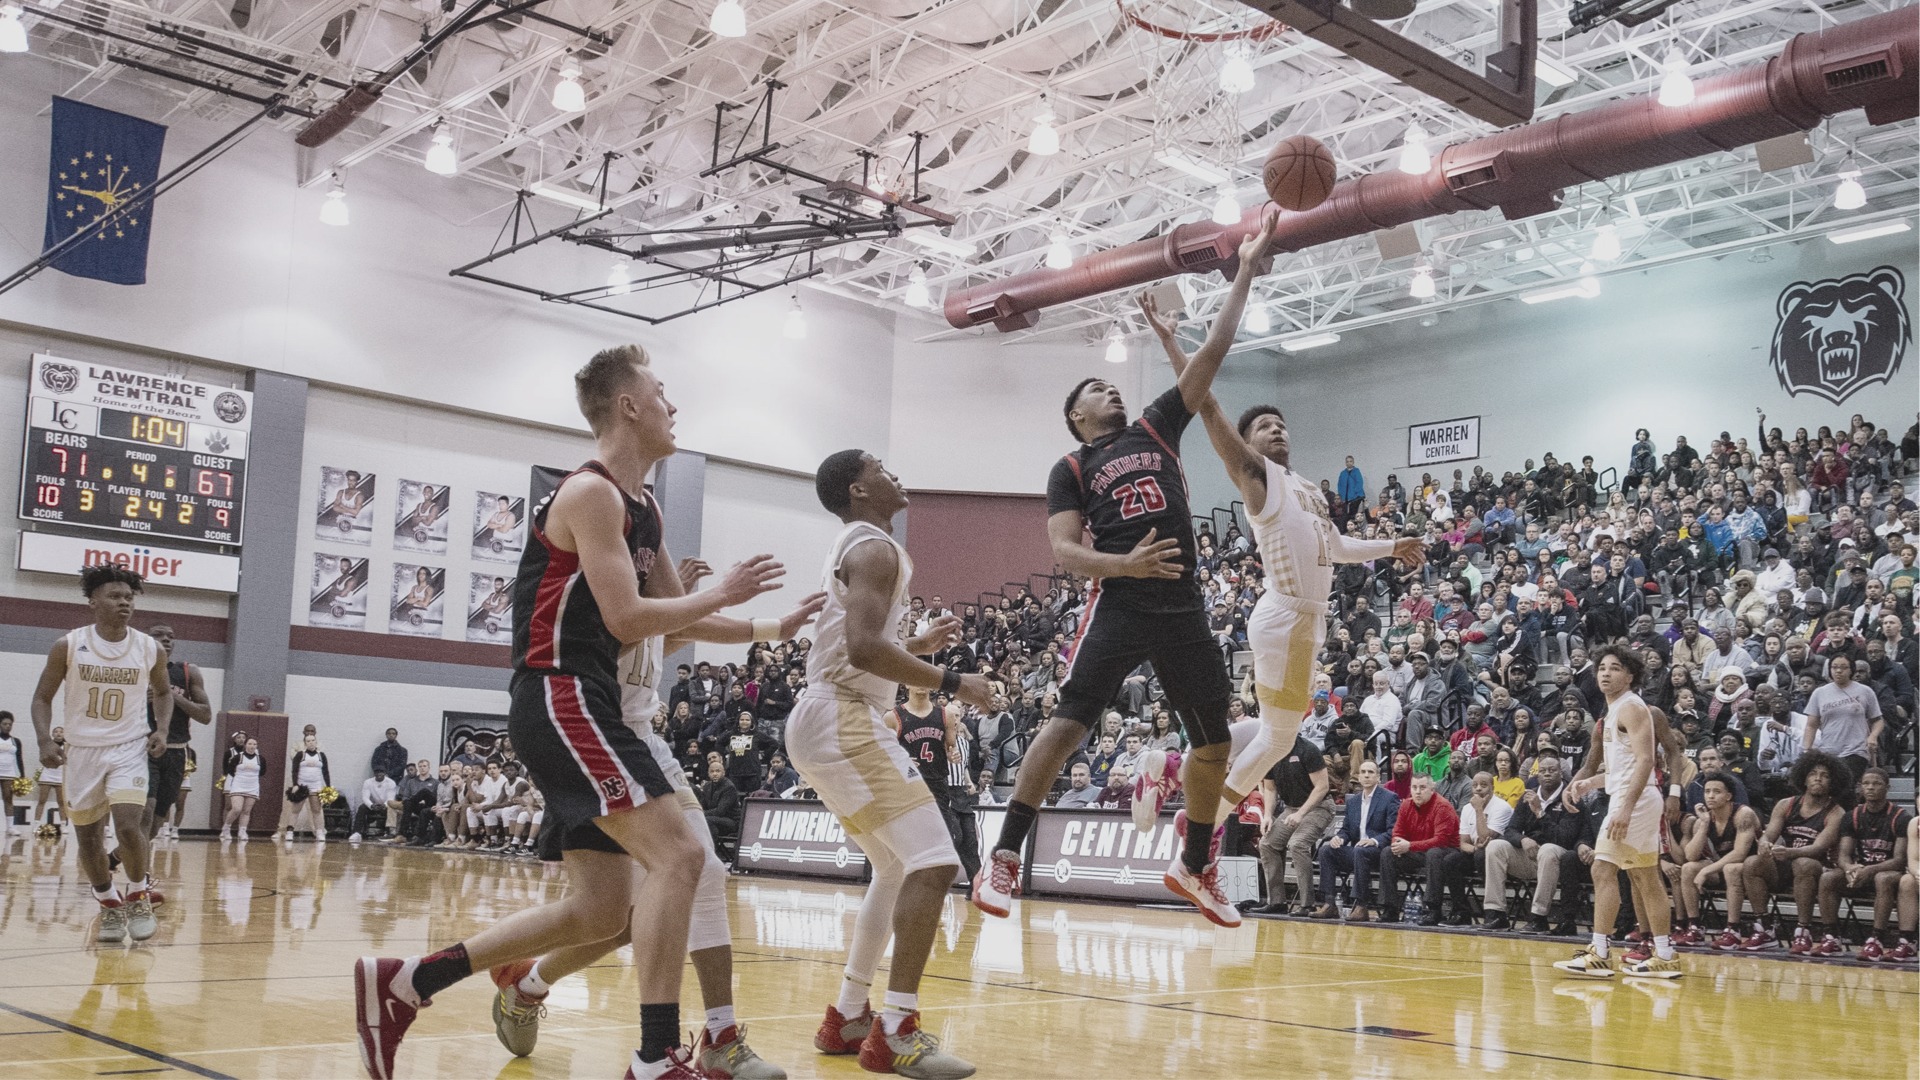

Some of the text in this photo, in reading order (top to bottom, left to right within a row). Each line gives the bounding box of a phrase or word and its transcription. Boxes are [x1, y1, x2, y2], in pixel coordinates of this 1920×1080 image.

[89, 367, 206, 397] LAWRENCE
[98, 382, 197, 409] CENTRAL
[92, 396, 129, 408] Home
[131, 400, 143, 409] of
[144, 405, 165, 414] the
[166, 408, 201, 420] Bears
[45, 431, 88, 449] BEARS
[131, 415, 184, 445] 1:04
[1419, 424, 1469, 446] WARREN
[52, 447, 87, 476] 71
[126, 450, 157, 462] PERIOD
[193, 454, 233, 470] GUEST
[1425, 444, 1461, 459] CENTRAL
[36, 474, 66, 487] FOULS
[131, 463, 148, 482] 4
[198, 470, 233, 496] 67
[1090, 452, 1162, 496] PANTHERS
[38, 485, 60, 506] 10
[79, 489, 95, 511] 3
[108, 484, 167, 500] PLAYER FOUL
[1113, 475, 1167, 520] 20
[33, 508, 64, 520] SCORE
[178, 503, 194, 524] 2
[207, 498, 234, 510] FOULS
[121, 519, 151, 531] MATCH
[215, 508, 229, 527] 9
[204, 530, 232, 541] SCORE
[84, 548, 182, 580] meijer
[78, 663, 140, 686] WARREN
[86, 686, 125, 721] 10
[903, 726, 945, 744] PANTHERS
[920, 741, 934, 763] 4
